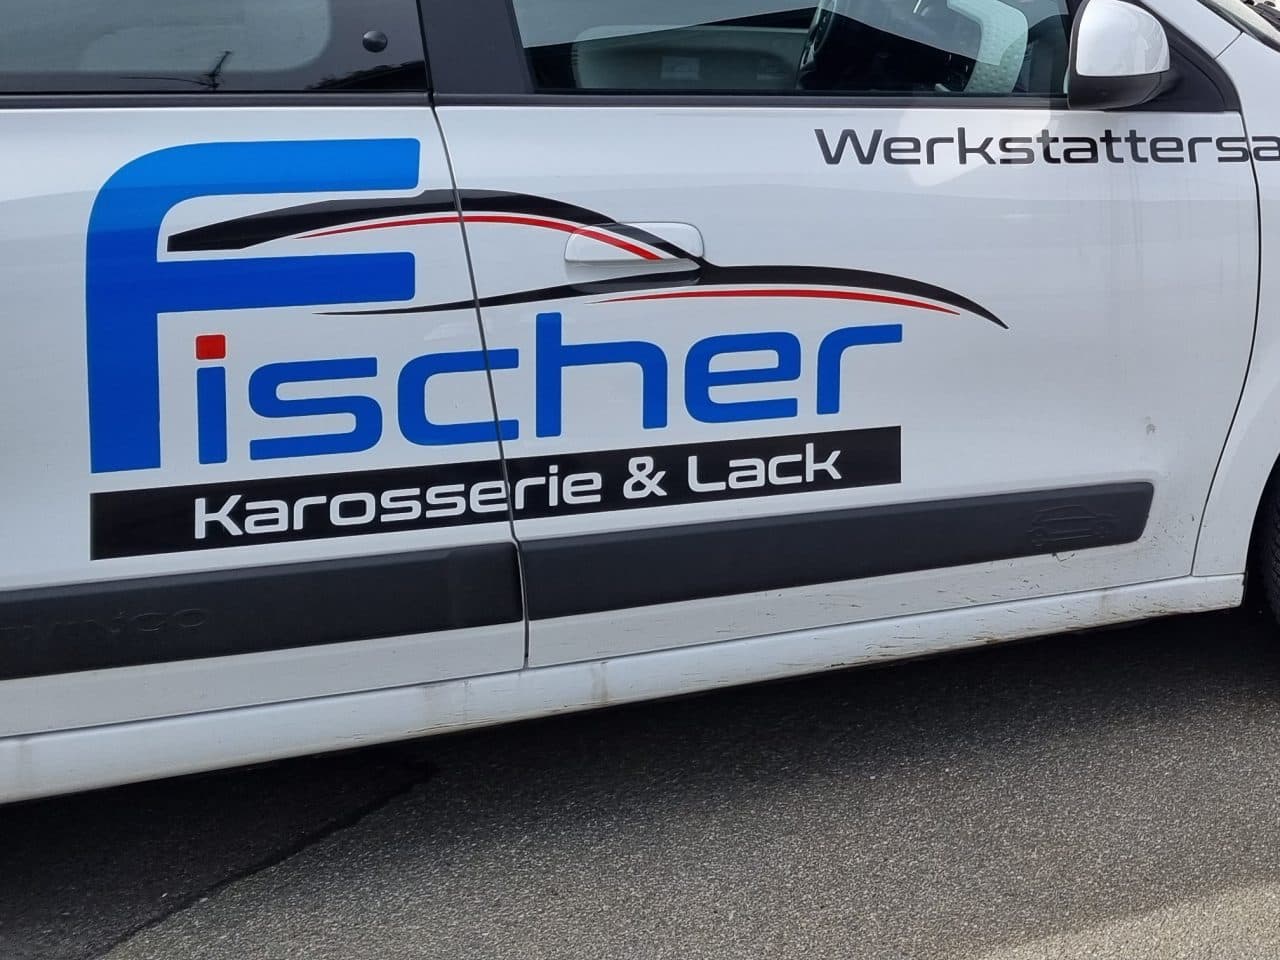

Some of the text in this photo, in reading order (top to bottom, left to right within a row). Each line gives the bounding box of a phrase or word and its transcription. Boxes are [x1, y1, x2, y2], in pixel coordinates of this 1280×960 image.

[86, 137, 903, 474] Fischer
[194, 442, 843, 540] Karosserie & Lack
